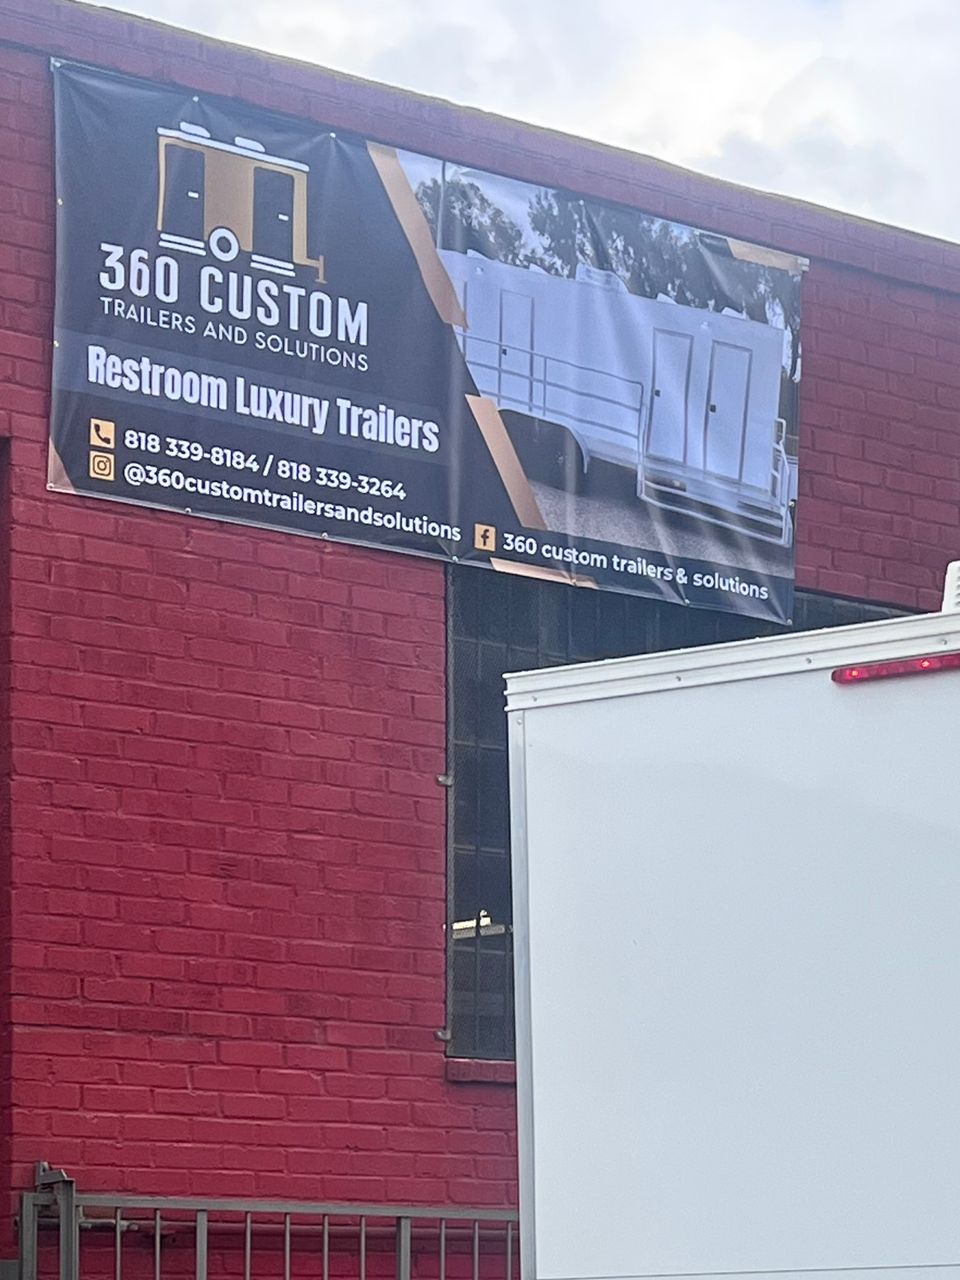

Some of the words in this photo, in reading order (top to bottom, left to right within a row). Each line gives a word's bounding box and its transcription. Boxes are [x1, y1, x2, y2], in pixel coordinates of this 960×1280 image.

[99, 242, 179, 304] 360
[200, 265, 369, 346] CUSTOM
[99, 295, 196, 334] TRAILERS
[203, 320, 248, 345] AND
[255, 332, 369, 372] SOLUTIONS
[87, 344, 228, 411] Restroom
[236, 377, 329, 435] Luxury
[336, 397, 440, 454] Trailers
[123, 462, 462, 542] @360customtrailersandsolutions
[124, 429, 161, 455] 818
[165, 436, 260, 474] 339-8184
[263, 454, 275, 477] /
[277, 458, 312, 484] 818
[315, 466, 407, 501] 339-3264
[503, 532, 538, 556] 360
[541, 543, 608, 569] custom
[612, 554, 674, 582] trailers
[676, 567, 689, 584] &
[692, 571, 769, 601] solutions
